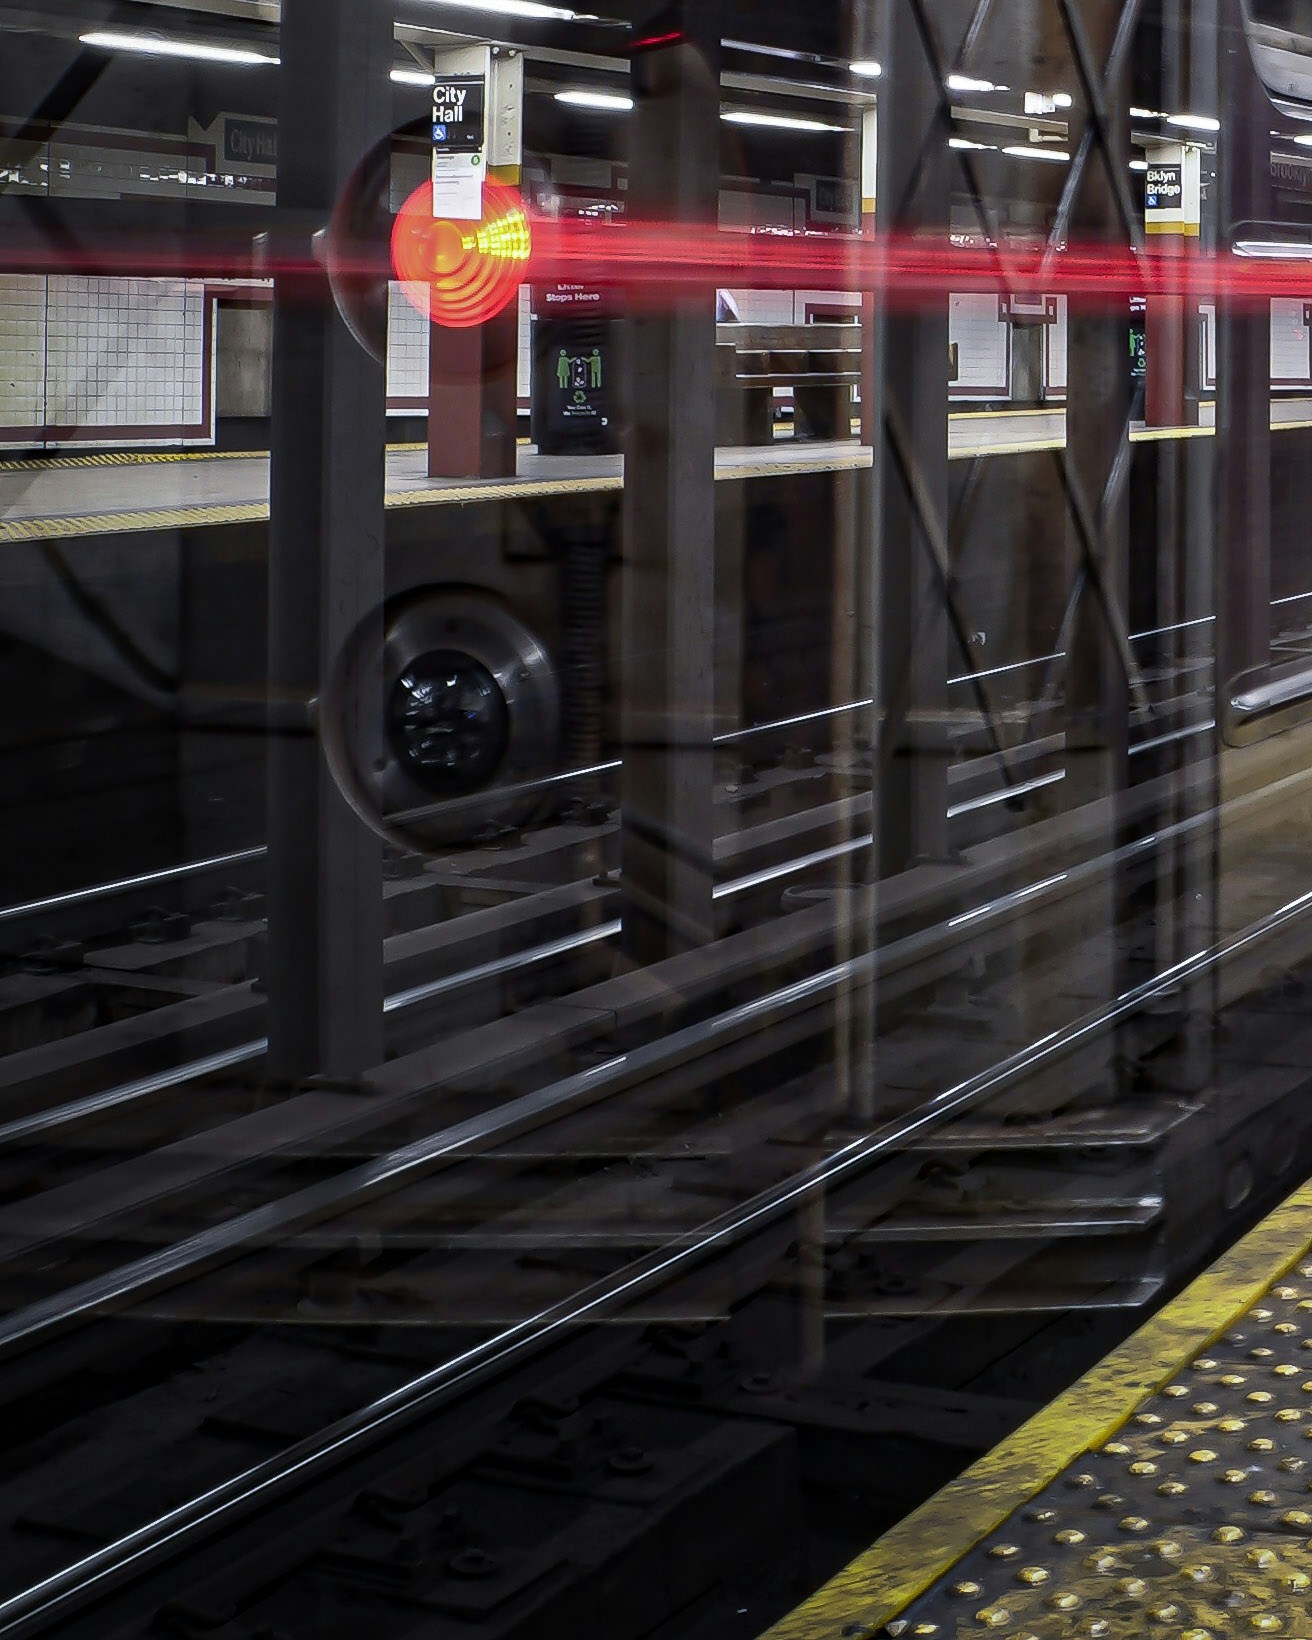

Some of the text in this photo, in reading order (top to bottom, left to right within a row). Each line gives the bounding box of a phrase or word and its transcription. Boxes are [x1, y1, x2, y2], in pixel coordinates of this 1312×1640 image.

[432, 86, 467, 106] City
[432, 105, 463, 123] Hall
[1146, 170, 1176, 183] Bklyn
[1146, 183, 1181, 197] Bridge
[545, 293, 600, 302] Stops Here
